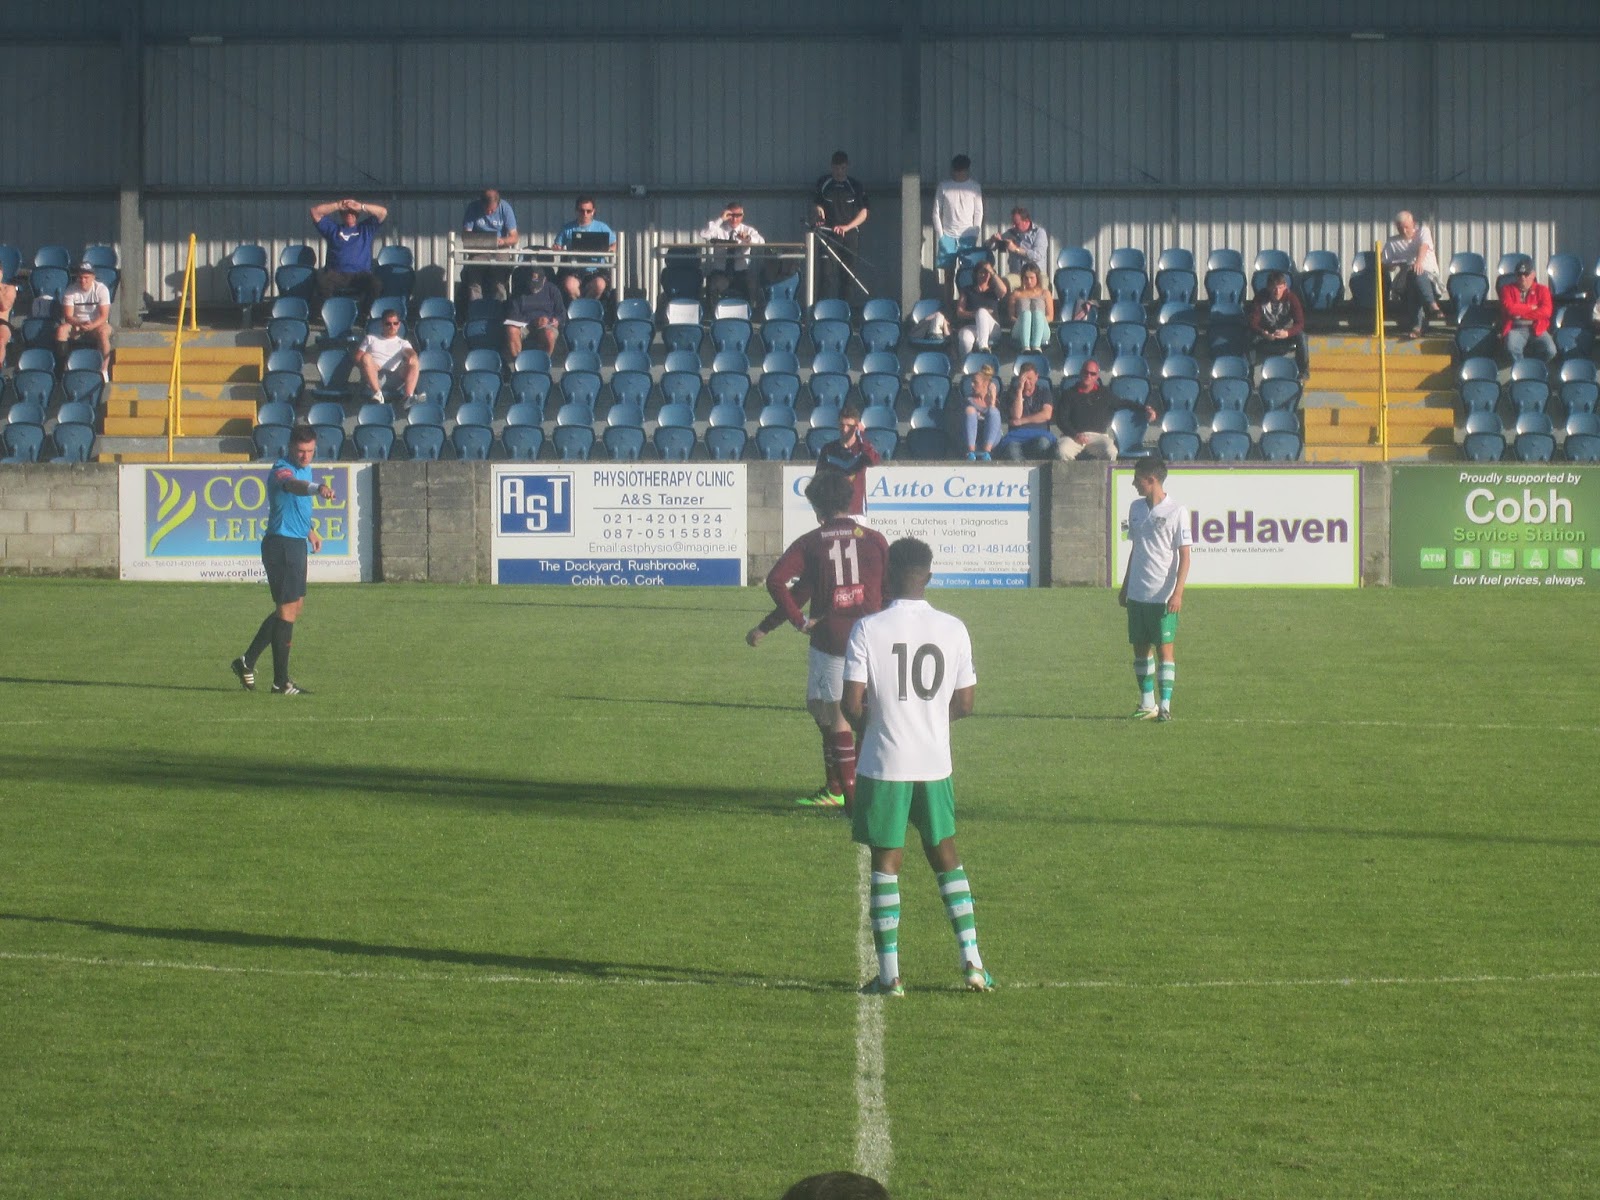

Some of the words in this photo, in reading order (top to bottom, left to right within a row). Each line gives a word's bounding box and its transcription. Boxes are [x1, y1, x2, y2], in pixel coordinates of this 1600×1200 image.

[593, 470, 693, 487] PHYSIOTHERAPY
[696, 470, 735, 487] CLINIC
[1459, 472, 1503, 485] Proudly
[1505, 472, 1564, 485] supported
[1567, 473, 1581, 485] by
[203, 475, 346, 511] COL
[869, 475, 934, 498] Auto
[943, 475, 1031, 498] Centre
[620, 493, 652, 506] A&S
[658, 493, 704, 506] Tanzer
[1465, 488, 1572, 524] Cobh
[603, 513, 722, 524] 021-4201924
[870, 518, 898, 526] Brakes
[910, 517, 948, 526] Clutches
[960, 517, 1009, 527] Diagnostics
[206, 516, 346, 542] LEIRE
[603, 528, 722, 539] 087-0515583
[885, 528, 901, 537] Car
[905, 528, 928, 537] Wash
[941, 529, 977, 538] Valeting
[1190, 510, 1348, 544] leHaven
[1453, 527, 1518, 542] Service
[1525, 527, 1585, 542] Station
[938, 544, 956, 553] Tel:
[828, 538, 860, 585] 11
[1422, 553, 1445, 563] ATM
[200, 568, 268, 577] www.coralleis
[539, 561, 560, 571] The
[565, 561, 624, 573] Dockyard,
[628, 560, 700, 572] Rushbrooke,
[610, 575, 631, 586] Co.
[635, 575, 665, 586] Cork
[1453, 575, 1477, 585] Low
[1480, 575, 1501, 585] fuel
[1504, 575, 1541, 586] prices,
[1545, 575, 1586, 587] always.
[892, 642, 945, 701] 10
